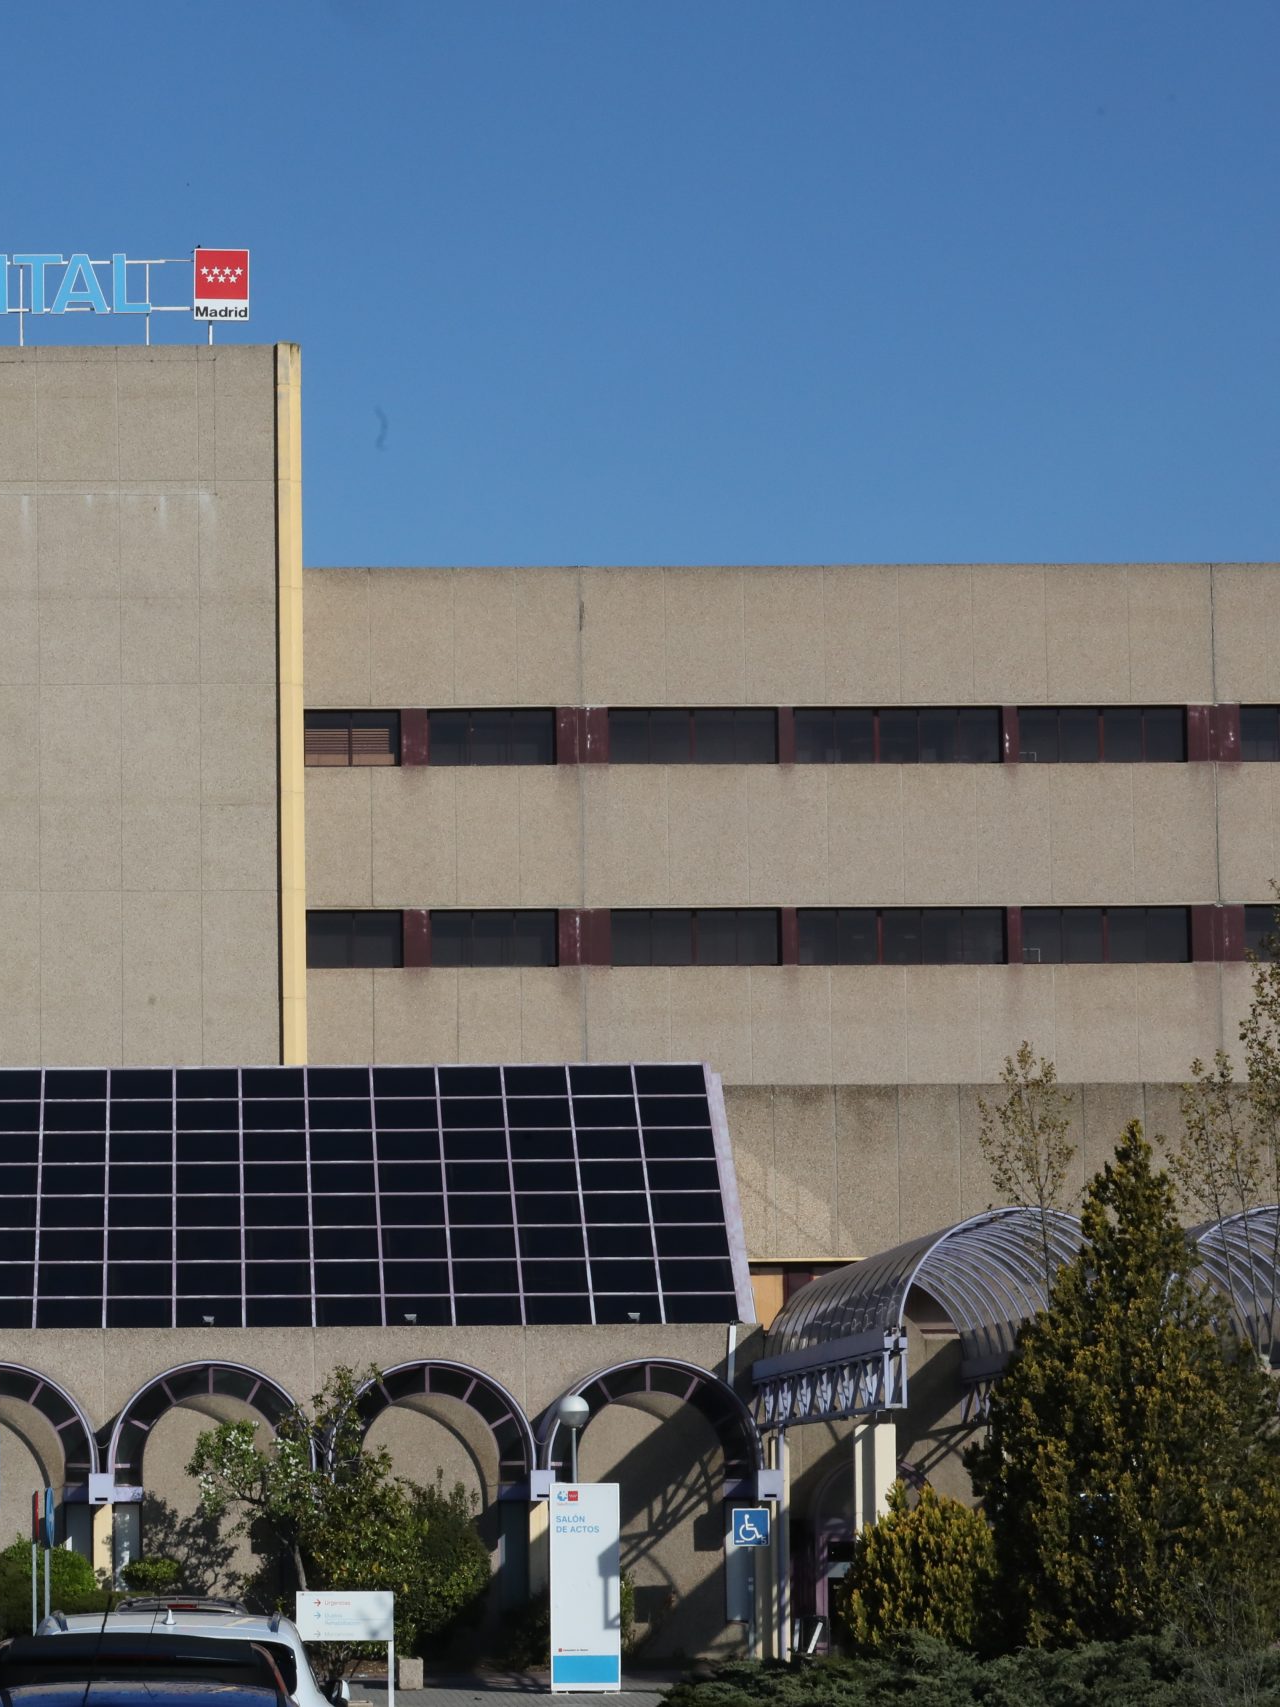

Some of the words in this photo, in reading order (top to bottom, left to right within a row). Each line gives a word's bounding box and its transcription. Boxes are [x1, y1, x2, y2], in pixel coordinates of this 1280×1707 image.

[195, 306, 248, 318] Madrid
[556, 1514, 585, 1523] SALÓN
[556, 1525, 568, 1533] DE
[570, 1525, 600, 1533] ACTOS
